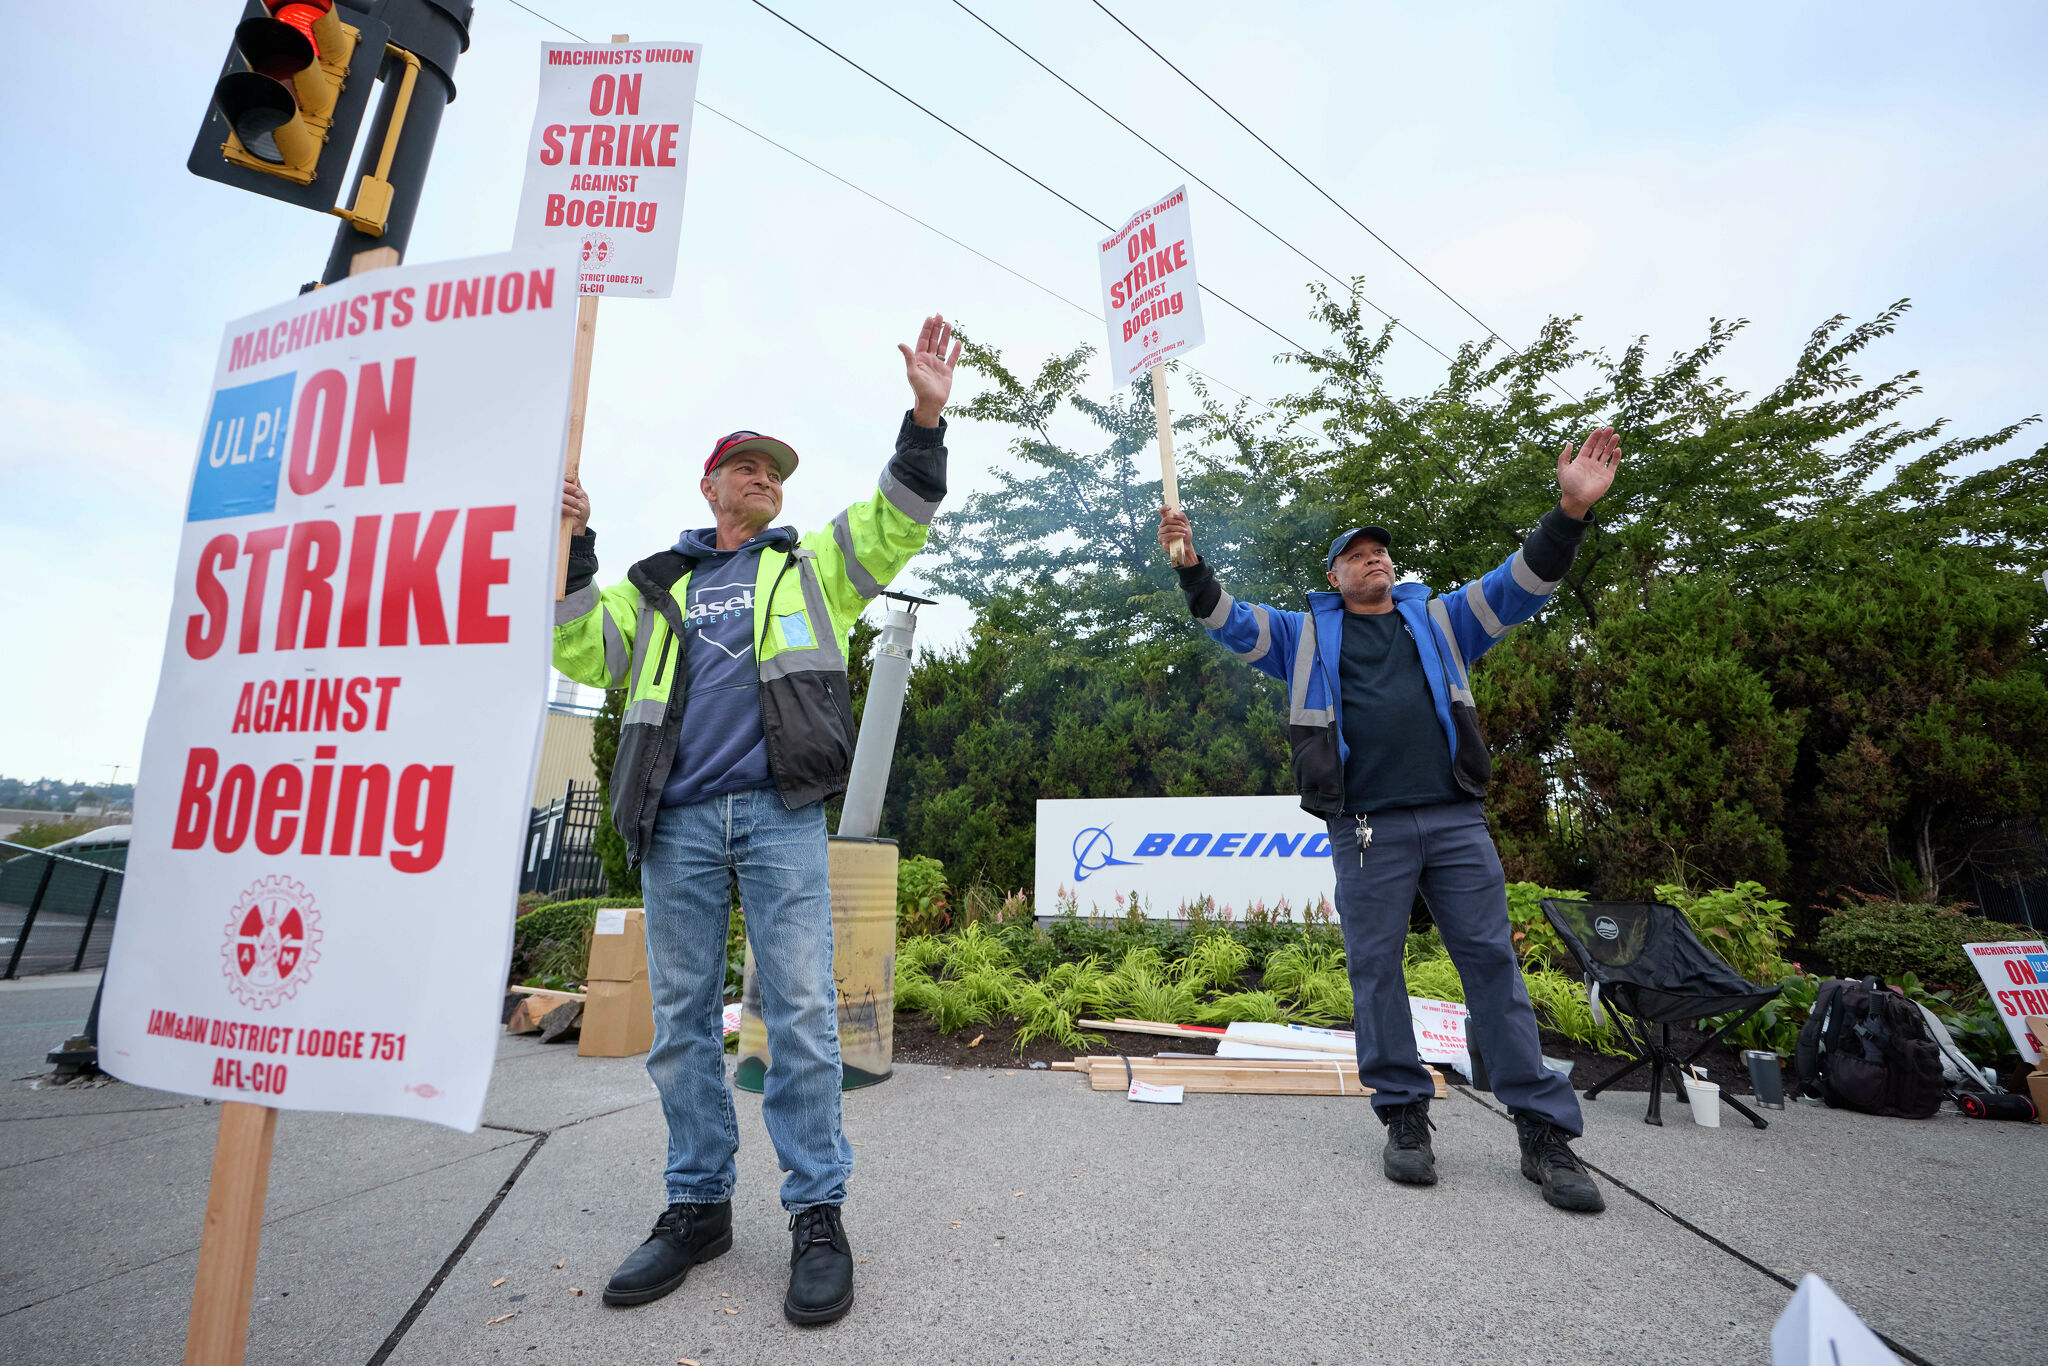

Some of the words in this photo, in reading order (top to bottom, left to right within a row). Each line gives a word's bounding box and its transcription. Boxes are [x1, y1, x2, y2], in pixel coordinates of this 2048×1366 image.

[549, 50, 642, 66] MACHINISTS
[646, 49, 694, 64] UNION
[590, 73, 643, 117] ON
[540, 124, 680, 167] STRIKE
[570, 174, 639, 193] AGAINST
[545, 194, 658, 233] Boeing
[1102, 210, 1151, 253] MACHINISTS
[1153, 192, 1184, 216] UNION
[1128, 223, 1157, 264] ON
[580, 273, 606, 283] STRICT
[607, 274, 629, 284] LODGE
[630, 275, 643, 285] 751
[580, 283, 605, 294] FL-CIO
[1110, 240, 1188, 310] STRIKE
[1131, 282, 1166, 314] AGAINST
[228, 287, 416, 373] MACHINISTS
[425, 268, 556, 322] UNION
[1123, 292, 1184, 344] Boeing
[208, 407, 281, 469] ULP!
[289, 357, 417, 497] ON
[184, 505, 517, 661] STRIKE
[684, 590, 755, 621] aseb
[684, 609, 741, 629] OGERS
[231, 676, 403, 735] AGAINST
[171, 745, 455, 875] Boeing
[1133, 833, 1333, 858] BOEING
[1973, 945, 2021, 956] MACHINISTS
[2021, 945, 2044, 954] UNION
[2031, 961, 2048, 972] ULP
[2003, 960, 2039, 986] ON
[1997, 988, 2048, 1017] STRI
[147, 1009, 208, 1045] IAM&AW
[210, 1018, 294, 1055] DISTRICT
[295, 1028, 365, 1060] LODGE
[369, 1031, 407, 1062] 751
[212, 1057, 288, 1096] AFL-CIO
